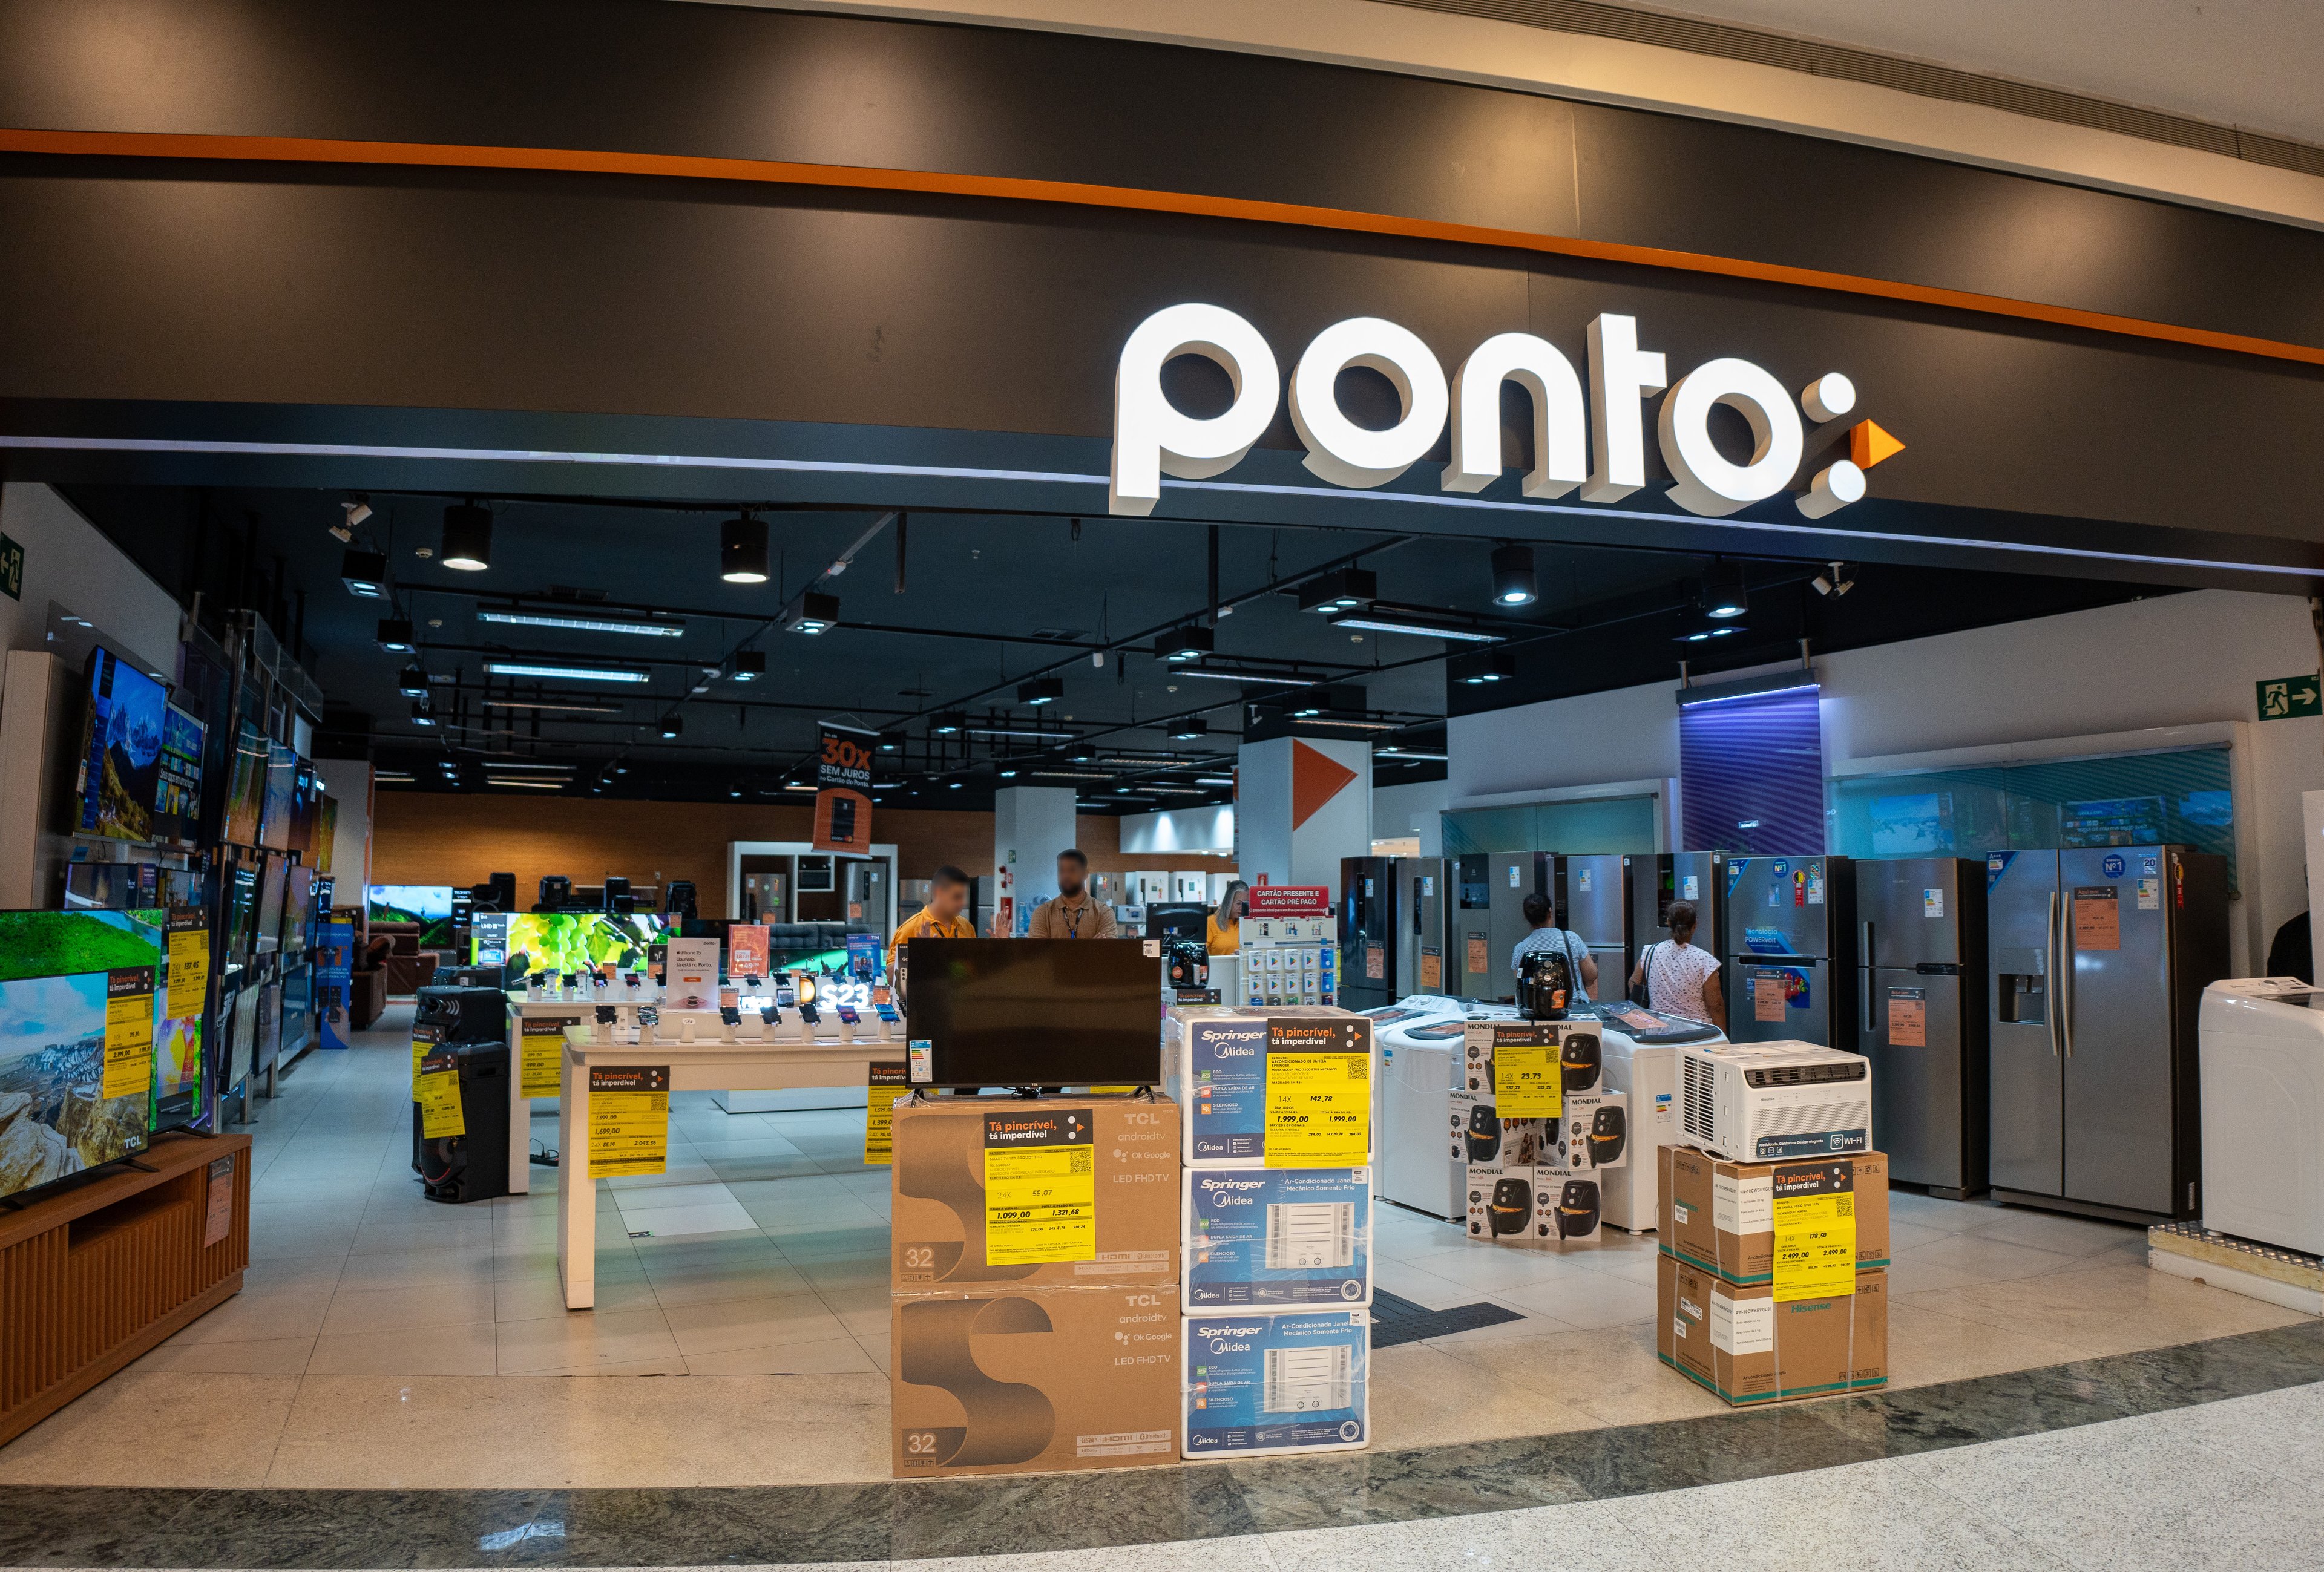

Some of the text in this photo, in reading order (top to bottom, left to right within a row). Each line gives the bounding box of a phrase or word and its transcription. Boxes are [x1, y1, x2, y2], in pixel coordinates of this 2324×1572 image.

[822, 738, 872, 770] 30x
[821, 765, 870, 780] SEM JUROS
[821, 984, 869, 1008] S23
[1201, 1030, 1267, 1043] Springer
[1272, 1027, 1336, 1038] Tá pincrível,
[1282, 1038, 1326, 1046] imperdível
[1215, 1042, 1255, 1058] Midea
[605, 1072, 643, 1081] pincrível,
[1124, 1113, 1160, 1125] TCL
[989, 1120, 1057, 1133] Tá pincrível,
[124, 1135, 142, 1148] TCL
[989, 1130, 1047, 1141] tá imperdível
[1144, 1151, 1170, 1160] Google
[1113, 1174, 1132, 1183] LED
[1135, 1174, 1154, 1182] FHD
[1776, 1171, 1826, 1184] Tá pincrível,
[1200, 1179, 1265, 1191] Springer
[1784, 1181, 1819, 1191] imperdível
[1213, 1190, 1253, 1208] Midea
[907, 1248, 933, 1268] 32
[1125, 1294, 1161, 1307] TCL
[1791, 1303, 1831, 1313] Hisense
[1145, 1332, 1172, 1341] Google
[1196, 1326, 1262, 1339] Springer
[1210, 1337, 1250, 1354] Midea
[909, 1435, 934, 1453] 32
[1193, 1435, 1218, 1446] Midea
